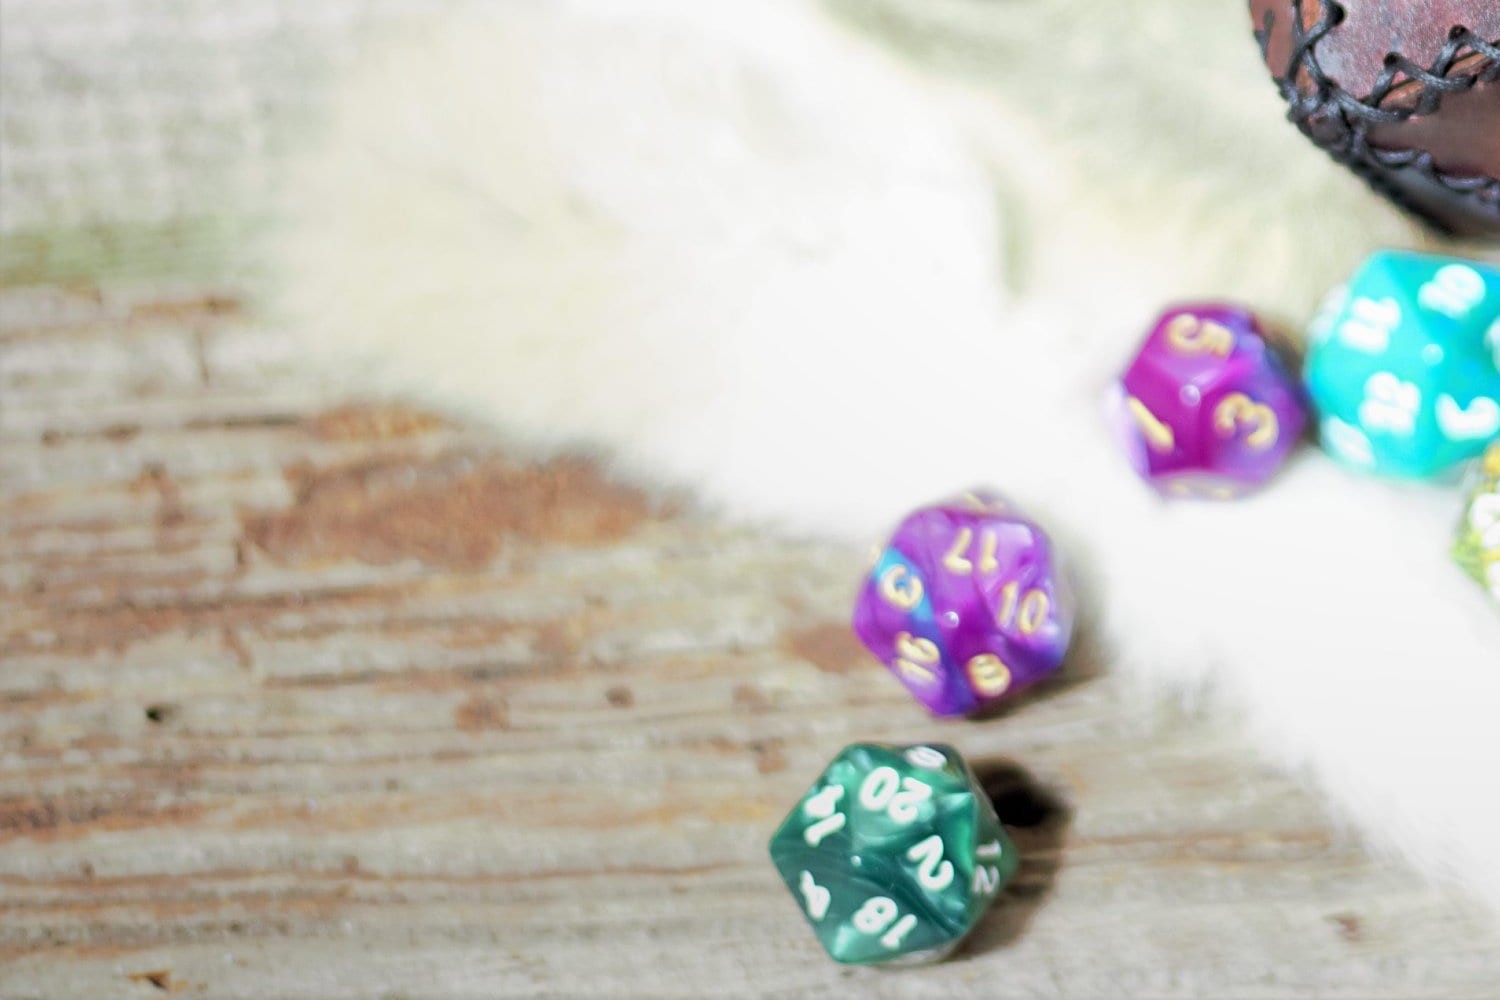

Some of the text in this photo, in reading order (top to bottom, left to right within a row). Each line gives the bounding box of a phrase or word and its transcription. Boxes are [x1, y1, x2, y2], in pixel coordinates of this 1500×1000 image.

[1213, 393, 1279, 450] 3
[943, 527, 998, 576] 17
[881, 565, 924, 611] 3
[997, 580, 1050, 636] 10
[859, 766, 933, 824] 20
[906, 834, 954, 891] 2
[853, 896, 918, 948] 18
